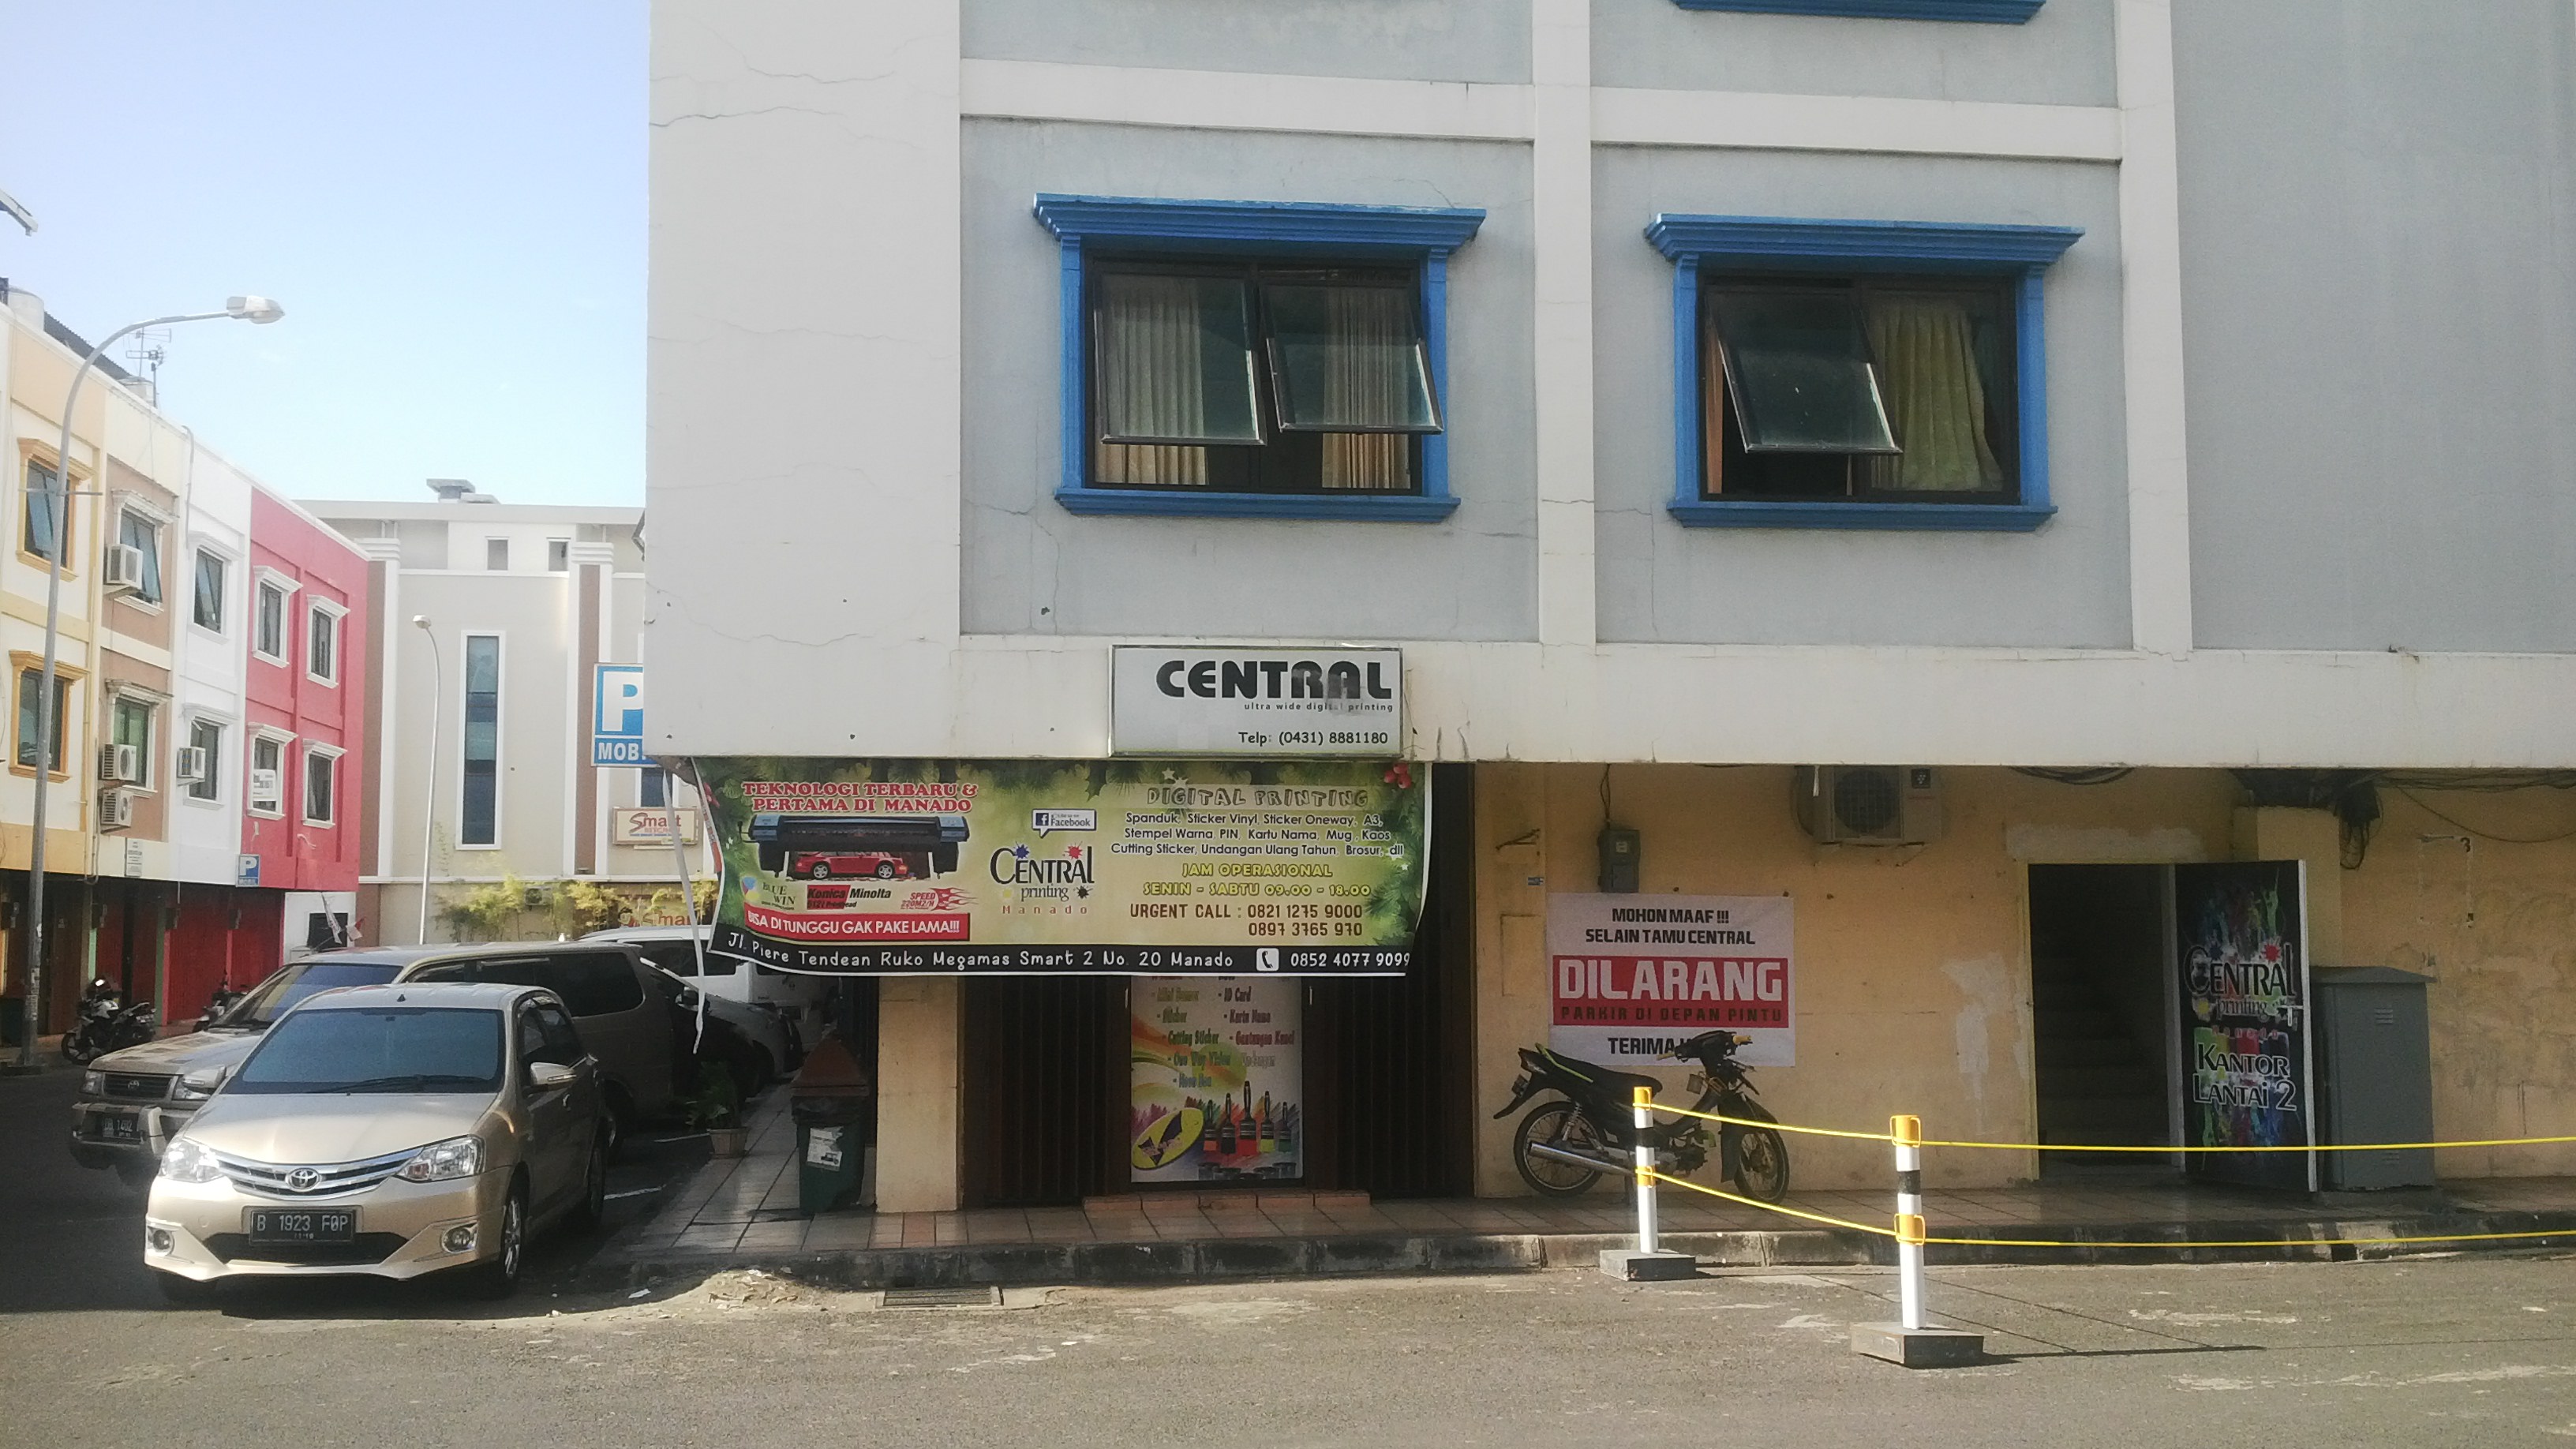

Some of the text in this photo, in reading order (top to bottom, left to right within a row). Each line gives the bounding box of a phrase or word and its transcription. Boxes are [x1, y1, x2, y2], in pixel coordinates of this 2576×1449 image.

[1156, 660, 1392, 699] CENTRAL
[602, 671, 643, 732] P
[1244, 702, 1271, 711] ultra
[1275, 702, 1301, 711] wide
[1348, 703, 1393, 713] printing
[1238, 731, 1388, 747] Telp: (0431) 8881180
[598, 742, 647, 761] MOB
[742, 782, 977, 798] TEKNOLOGI TERBARU &
[1147, 787, 1368, 807] DIGITAL PRINTING
[752, 798, 972, 812] PERTAMA DI MANADO
[629, 812, 682, 833] Smat
[1051, 818, 1091, 826] Facebook
[1187, 814, 1226, 824] Sticker
[1264, 814, 1302, 826] Sticker
[1125, 828, 1173, 841] Stempel
[1248, 829, 1278, 840] Kartu
[1361, 829, 1391, 841] Kaos
[1111, 843, 1153, 856] Cutting
[1156, 844, 1198, 855] Sticker,
[1201, 844, 1263, 856] Undangan
[1265, 844, 1299, 856] Ulang
[1390, 844, 1404, 856] dll
[239, 857, 257, 876] P
[1181, 863, 1333, 878] JAM OPERASIONAL
[807, 888, 892, 899] Konica Minolta
[910, 892, 937, 900] SPEED
[1021, 883, 1069, 902] printing
[1143, 882, 1192, 896] SENIN
[1209, 882, 1260, 896] SABTU
[1264, 884, 1312, 897] 09.00
[1329, 884, 1372, 897] 18.00
[773, 895, 796, 905] WIN
[642, 909, 692, 926] Sma
[1130, 904, 1189, 919] URGENT
[1195, 904, 1231, 919] CALL
[1248, 904, 1281, 918] 0821
[1286, 904, 1319, 918] 1275
[1324, 904, 1363, 918] 9000
[1612, 908, 1729, 924] MOHON MAAF !!!
[842, 921, 873, 934] GAK
[875, 921, 909, 934] PAKE
[912, 921, 960, 934] LAMA!!!
[1249, 922, 1362, 936] 0897 3765 970
[1586, 929, 1755, 945] SELAIN TAMU CENTRAL
[752, 940, 790, 963] Piere
[798, 950, 871, 967] Tendean
[880, 950, 923, 967] Ruko
[933, 951, 1010, 971] Megamas
[1019, 949, 1073, 967] Smart
[1083, 950, 1094, 966] 2
[1139, 951, 1161, 967] 20
[1170, 951, 1234, 967] Manado
[1290, 953, 1327, 967] 0852
[1333, 953, 1370, 967] 4077
[1376, 953, 1410, 967] 9099
[1559, 959, 1782, 1002] DILARANG
[1224, 986, 1251, 1002] ID Card
[1562, 1006, 1782, 1022] PARKIR DI DEPAN PINTU
[2216, 998, 2270, 1022] printing
[1608, 1038, 1675, 1054] TERIMA
[2197, 1043, 2290, 1077] KANTOR
[2275, 1080, 2297, 1111] 2
[256, 1215, 266, 1231] B
[279, 1215, 311, 1231] 1923
